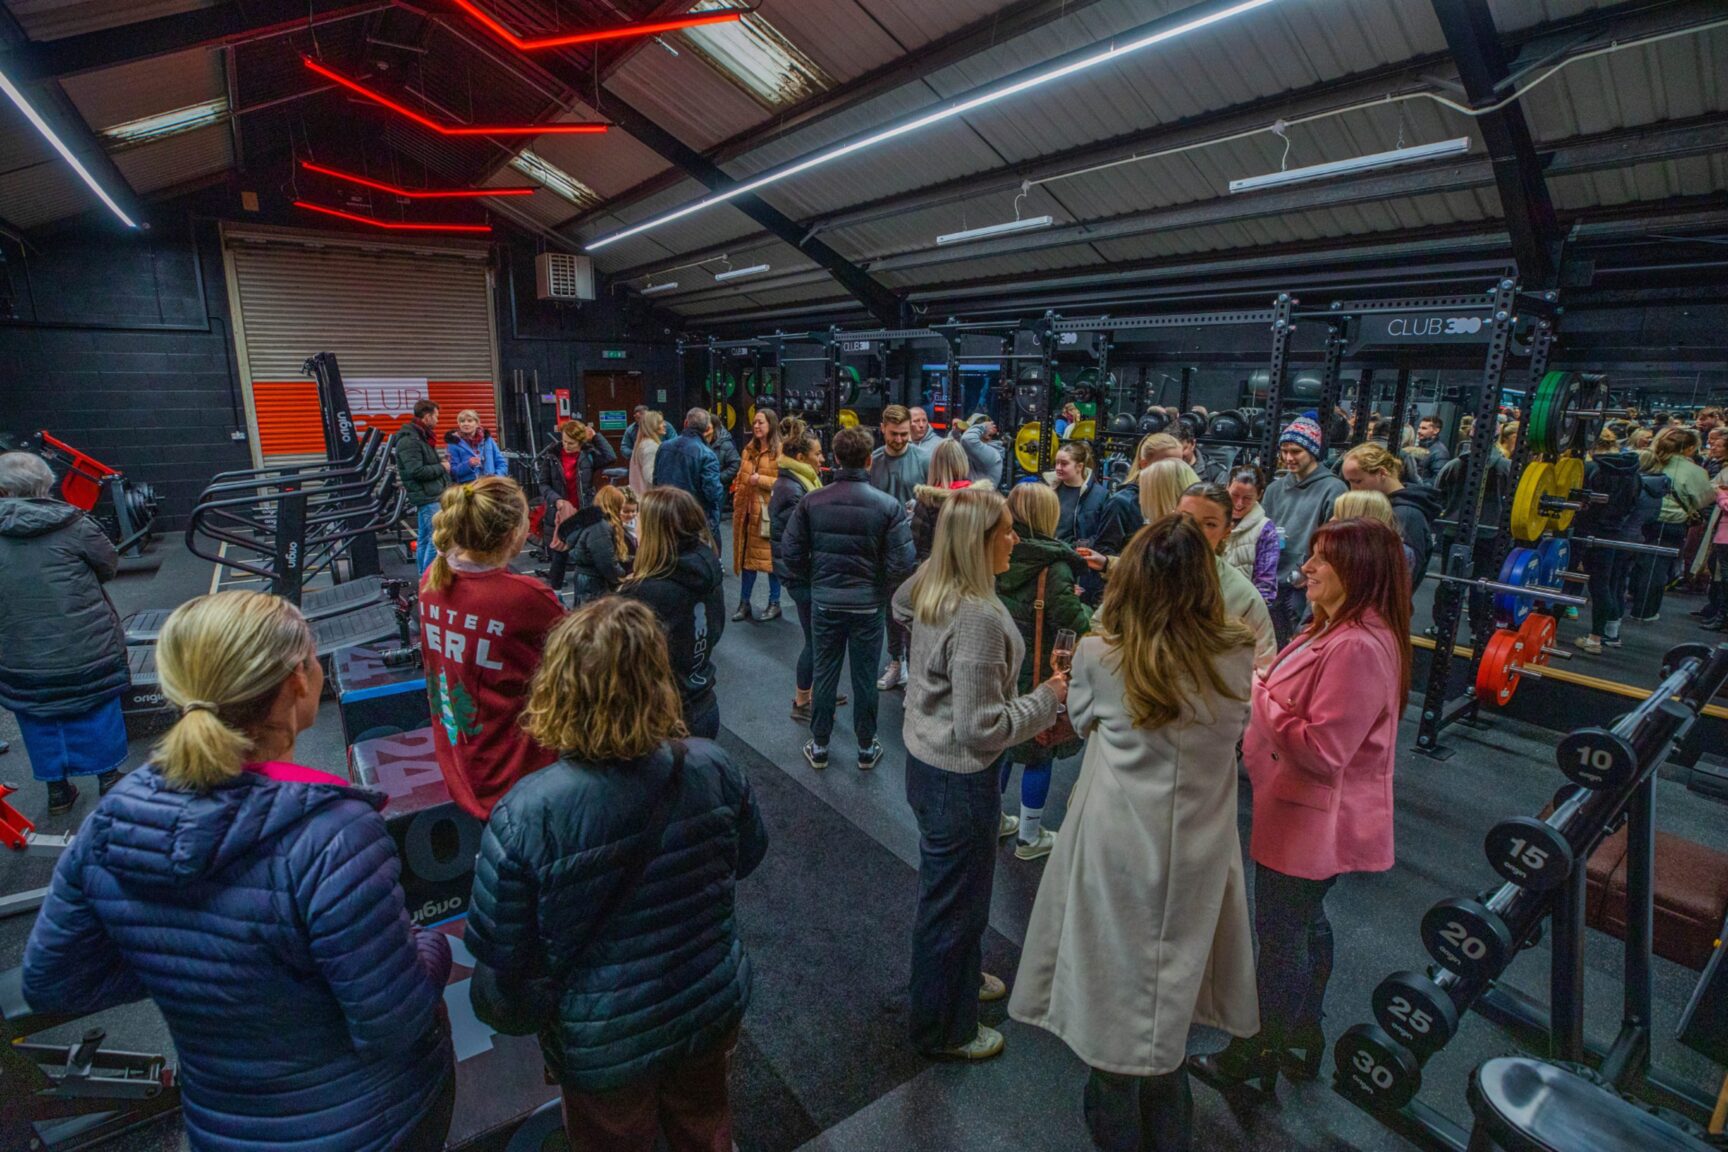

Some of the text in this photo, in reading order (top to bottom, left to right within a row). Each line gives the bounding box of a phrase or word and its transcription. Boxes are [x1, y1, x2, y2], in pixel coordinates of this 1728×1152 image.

[337, 411, 352, 442] origin
[285, 541, 298, 569] origin
[133, 693, 164, 704] origi
[1577, 746, 1613, 770] 10
[1510, 837, 1549, 870] 15
[1439, 921, 1487, 960] 20
[1387, 996, 1433, 1034] 25
[1352, 1049, 1394, 1089] 30
